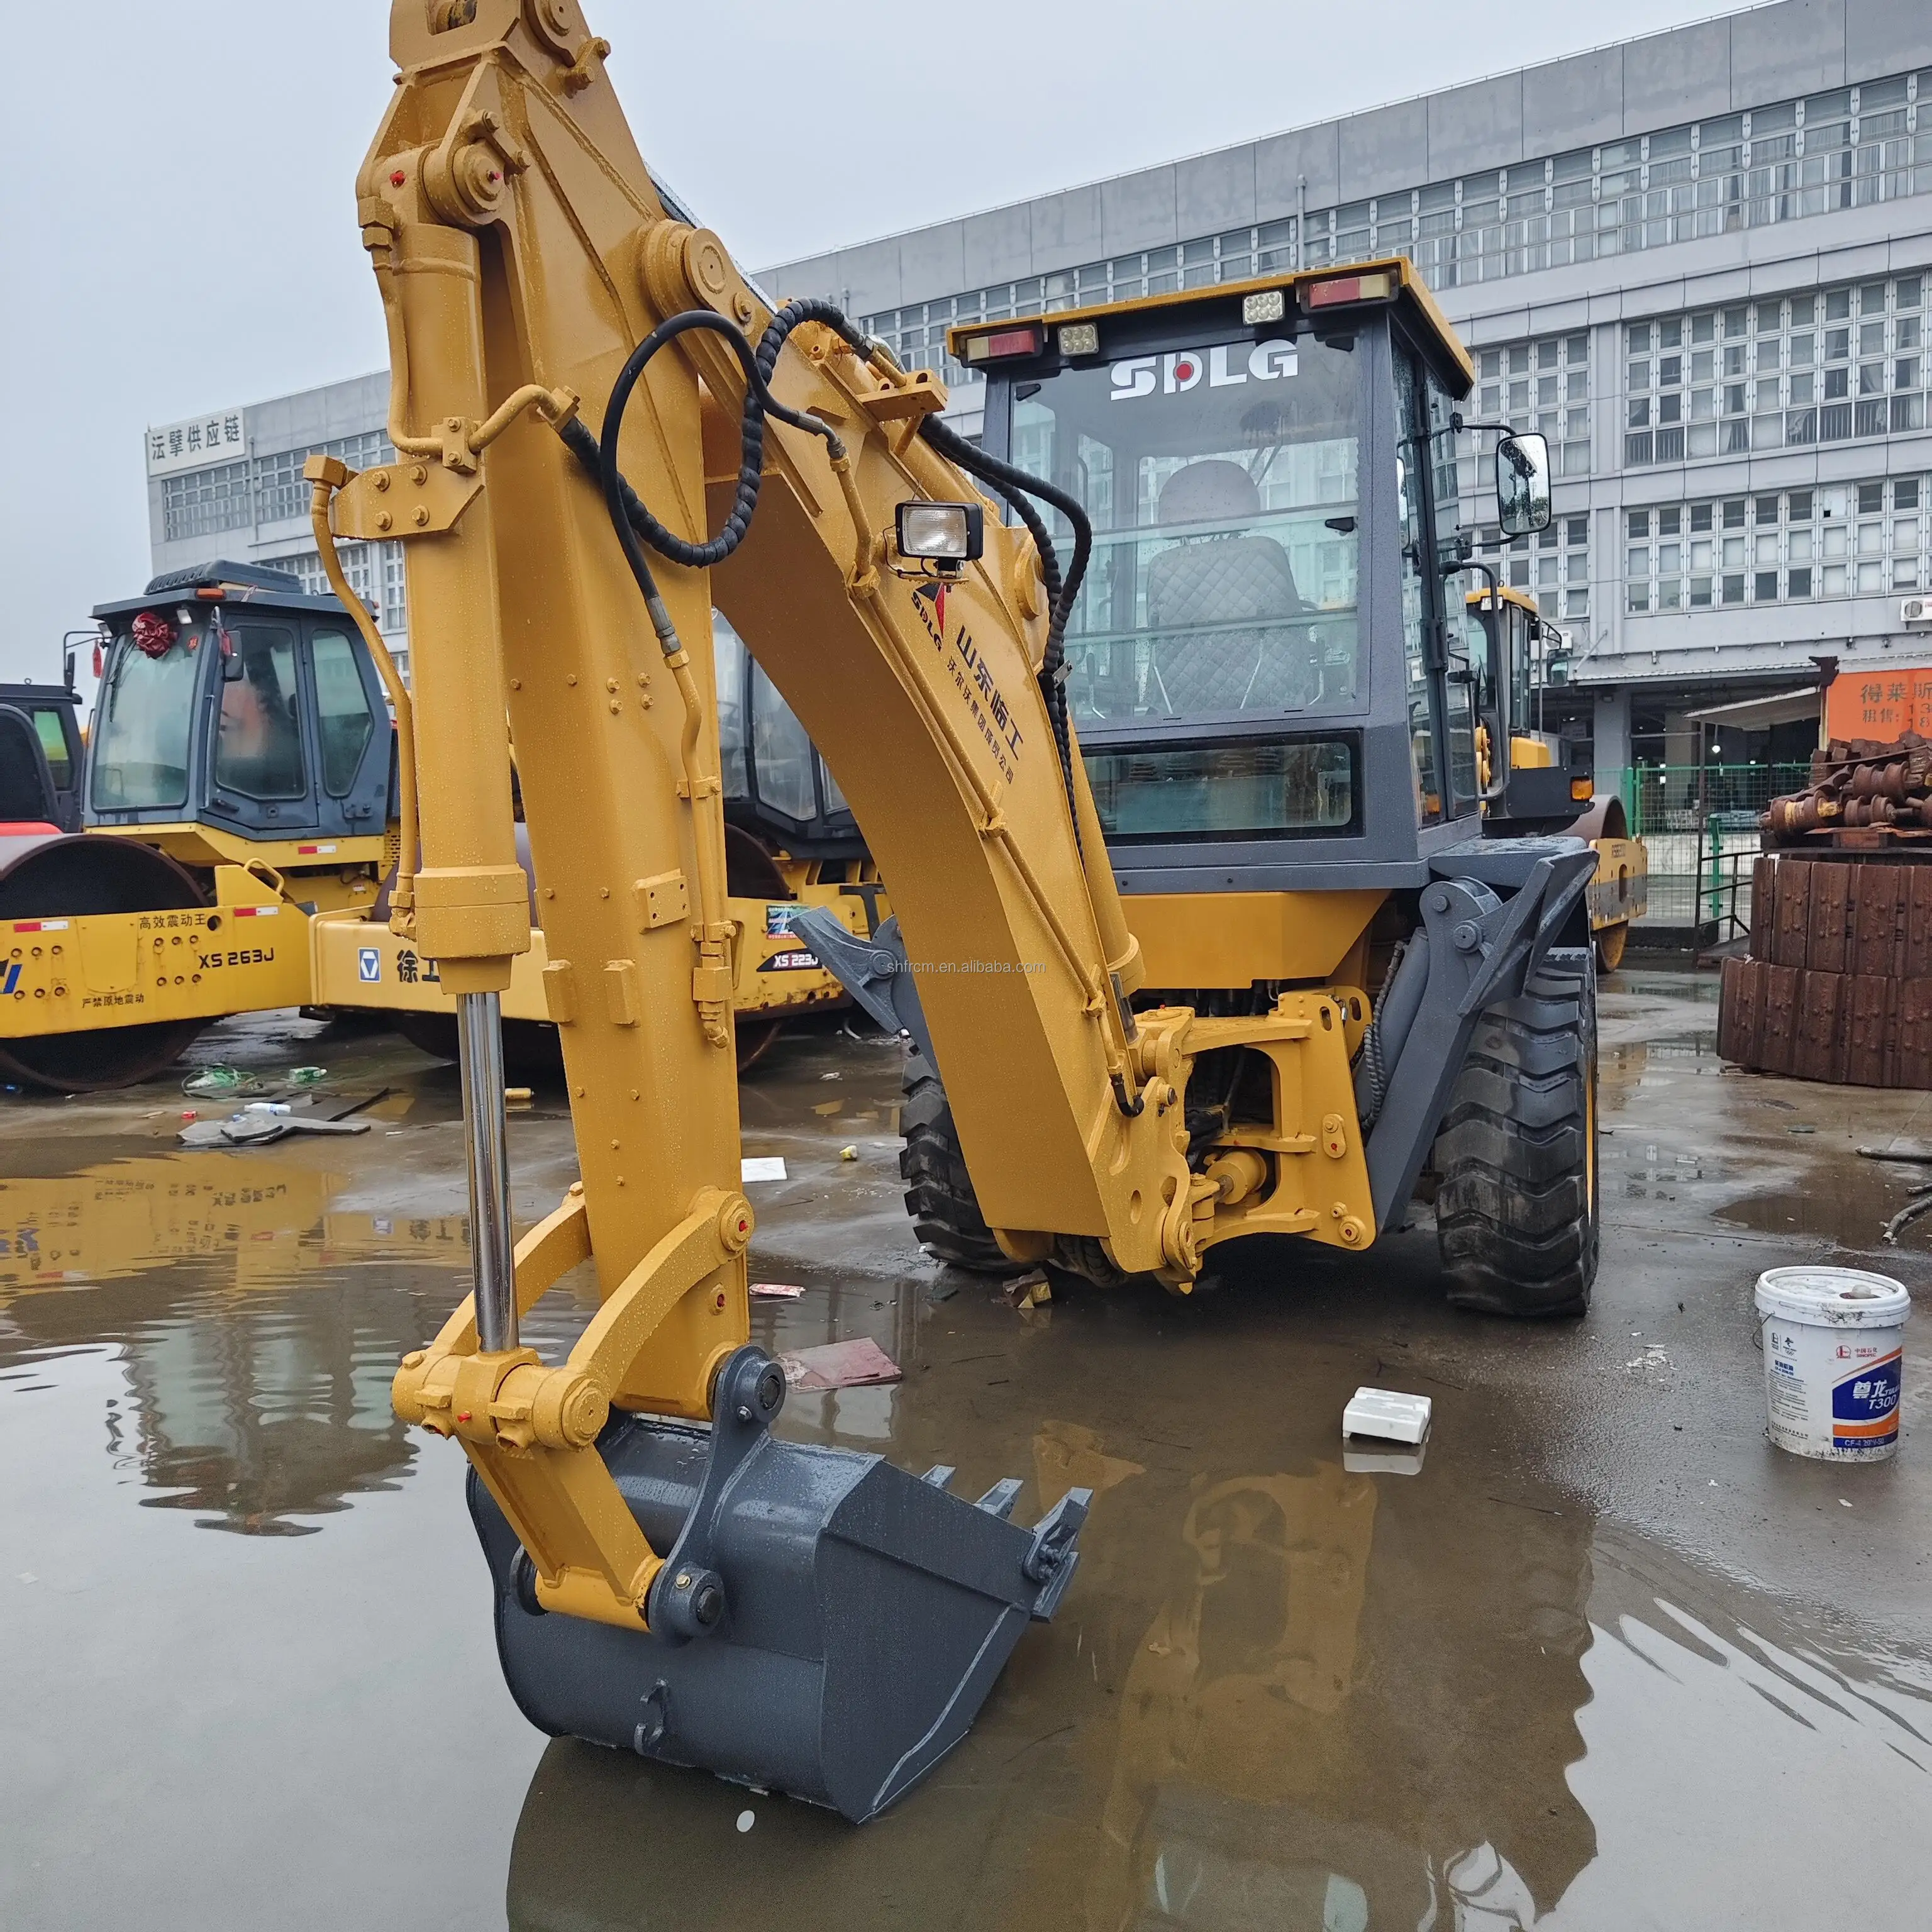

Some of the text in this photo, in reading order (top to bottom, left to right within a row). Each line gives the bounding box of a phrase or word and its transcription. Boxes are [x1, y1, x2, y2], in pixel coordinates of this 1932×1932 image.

[1111, 339, 1298, 401] SDLG
[911, 591, 942, 652] SDLG
[956, 625, 1024, 761] 山东临工
[947, 655, 1014, 784] 沃尔沃集团成员公司
[140, 914, 207, 930] 高效震动王
[198, 947, 274, 969] XS 263J
[774, 954, 789, 967] XS
[1852, 1379, 1887, 1399] 尊龙
[1868, 1393, 1897, 1410] T300
